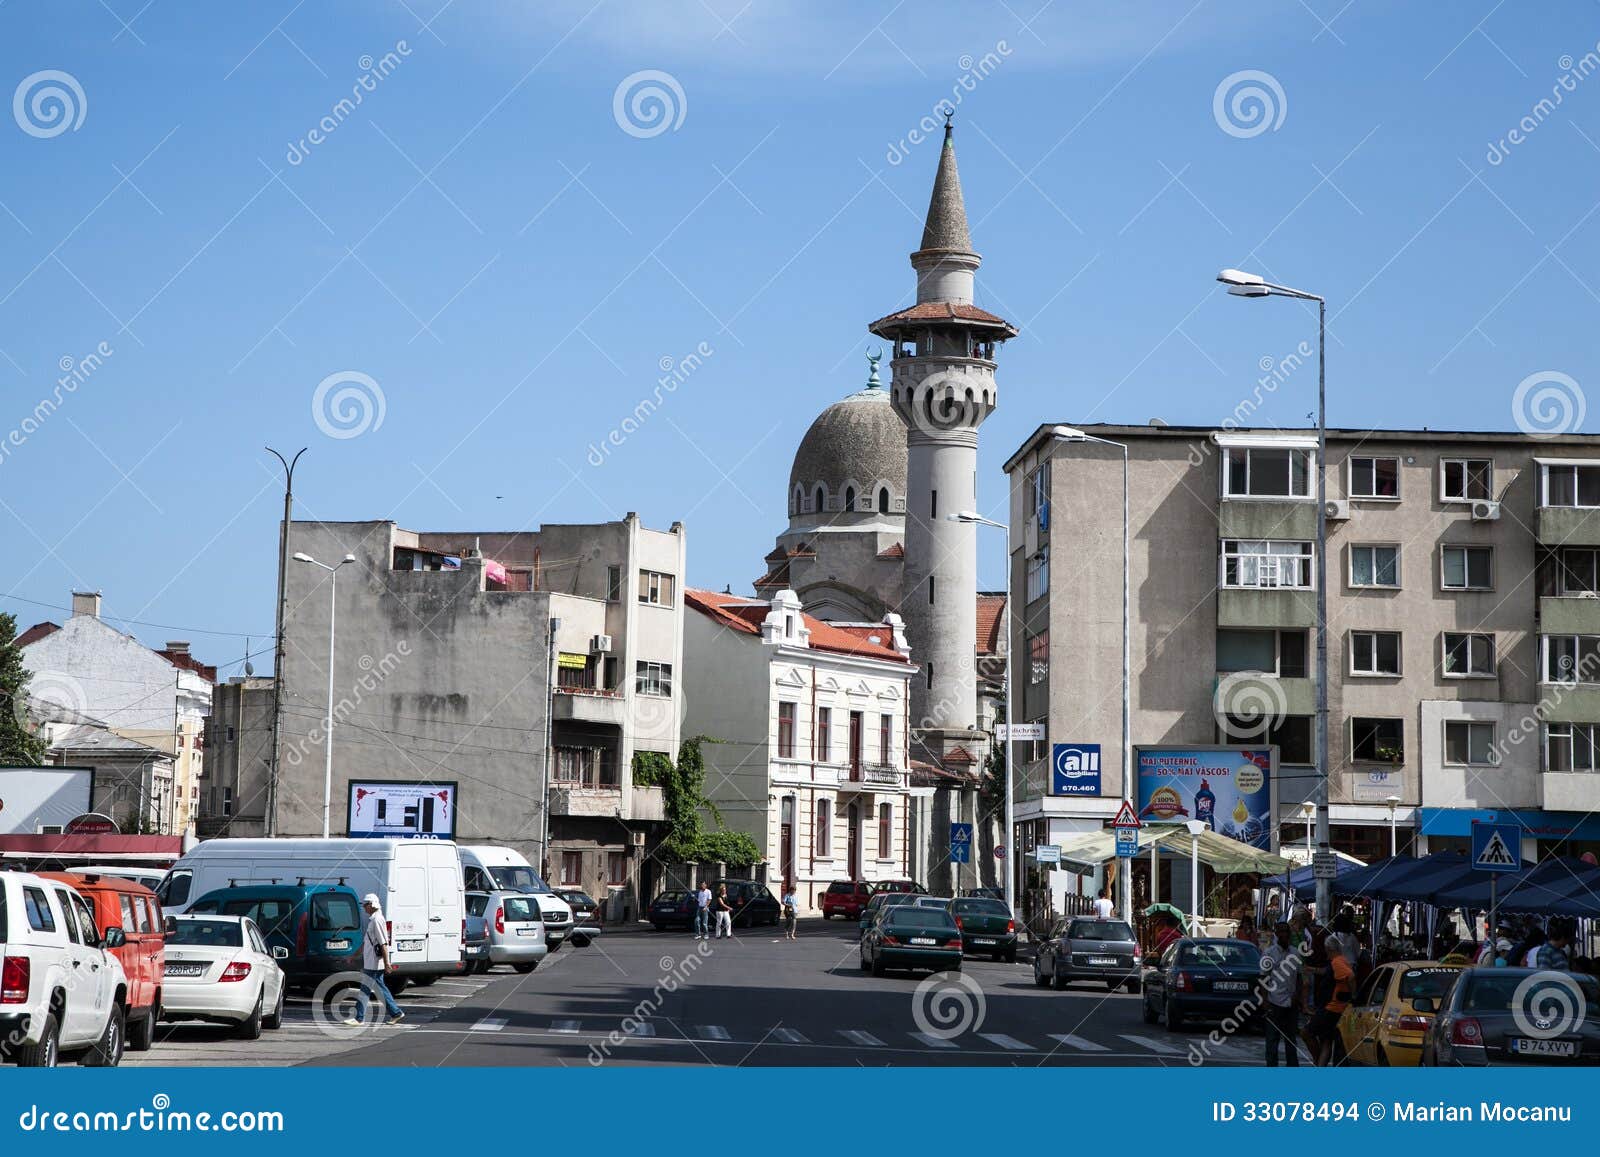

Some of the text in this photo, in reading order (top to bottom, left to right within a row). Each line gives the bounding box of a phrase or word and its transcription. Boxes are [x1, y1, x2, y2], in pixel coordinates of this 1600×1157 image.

[1064, 752, 1099, 771] all
[1178, 768, 1193, 776] MAI
[1520, 1039, 1570, 1051] B 74 XVY
